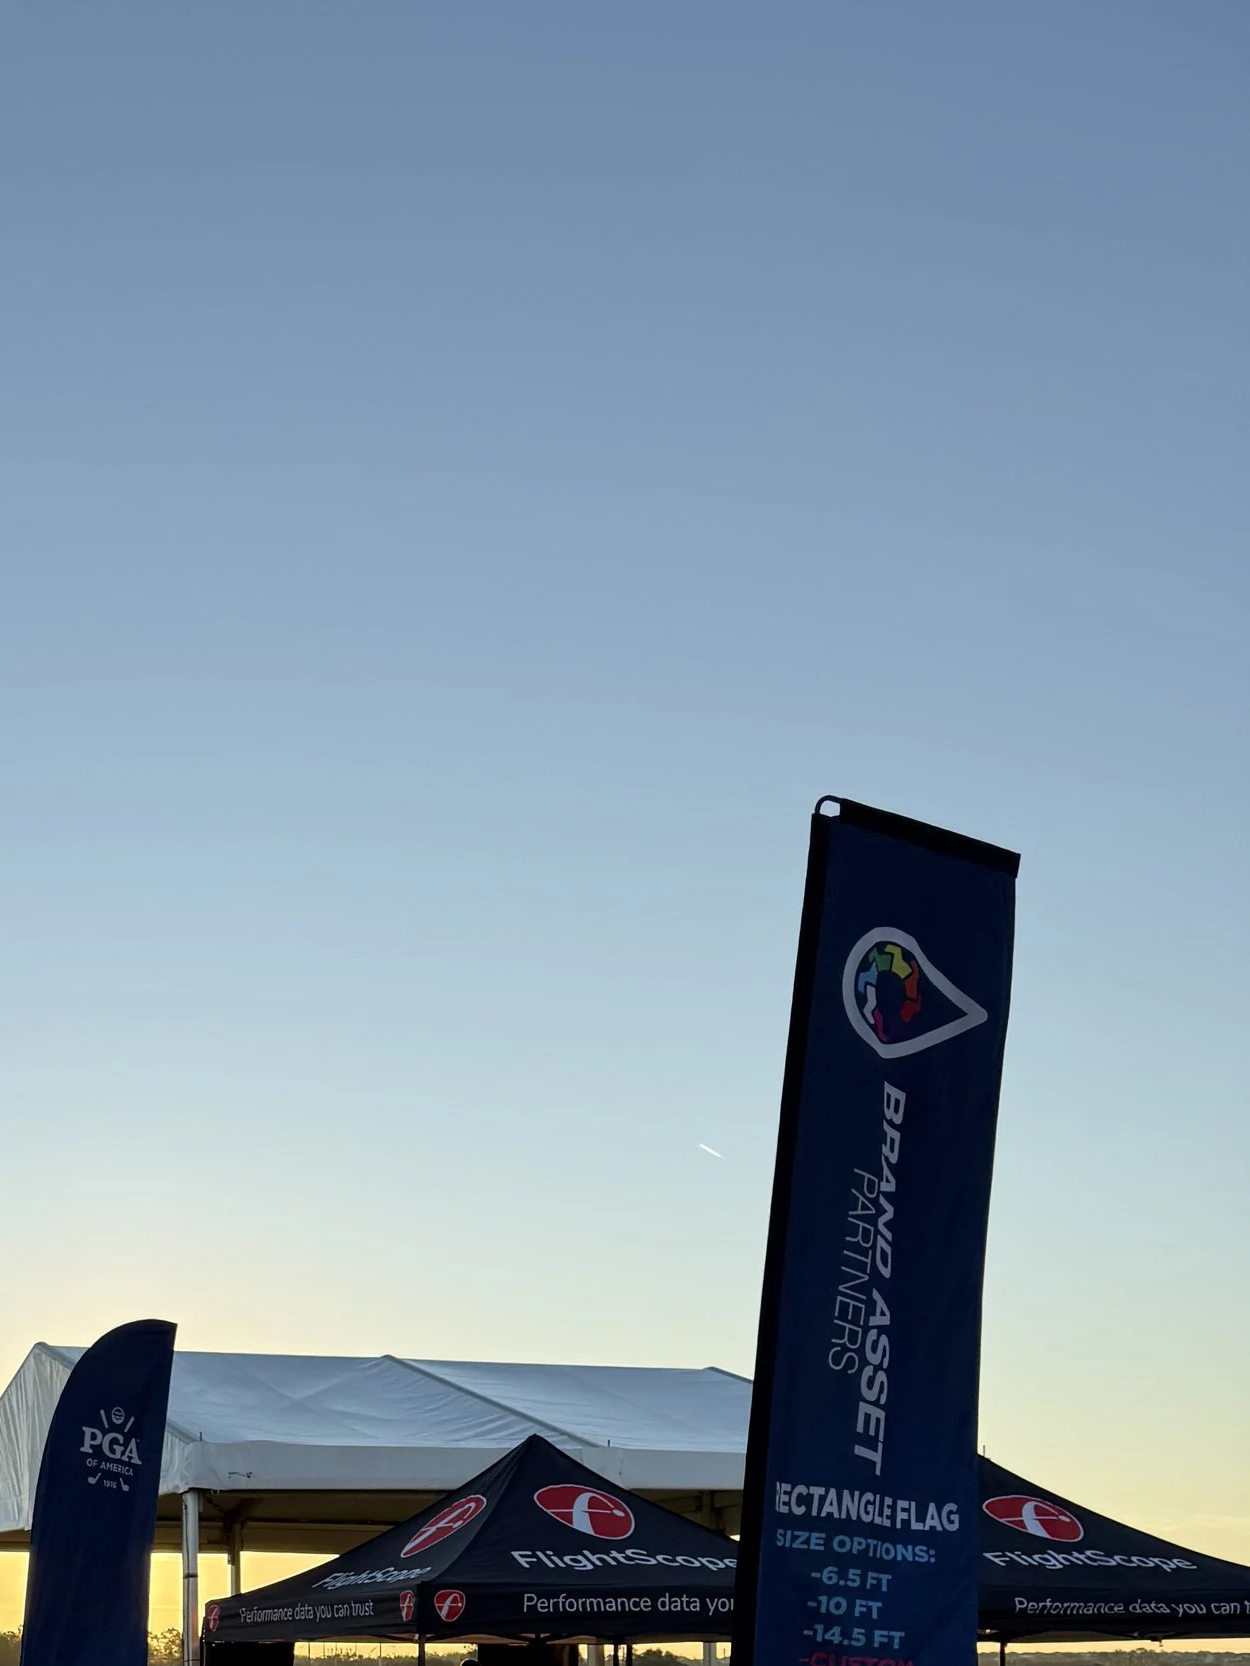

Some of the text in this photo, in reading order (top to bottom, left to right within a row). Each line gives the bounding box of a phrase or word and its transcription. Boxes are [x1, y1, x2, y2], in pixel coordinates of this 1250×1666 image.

[828, 1168, 878, 1374] PARTNERS
[854, 1080, 906, 1476] BRAND ASSET
[80, 1426, 143, 1465] PGA
[86, 1458, 134, 1477] OF AMERICA
[896, 1499, 959, 1532] FLAG
[776, 1528, 936, 1563] SIZE OPTIONS:
[511, 1549, 737, 1571] FlightScope
[983, 1549, 1197, 1573] FlightScope
[311, 1566, 432, 1590] FlightScope
[811, 1566, 892, 1592] -6.5 FT
[239, 1599, 374, 1623] Performance data you can trust
[523, 1593, 652, 1613] Performance
[657, 1593, 700, 1611] data
[854, 1599, 882, 1620] FT
[1014, 1597, 1126, 1614] Performance
[1129, 1599, 1170, 1614] data
[1171, 1600, 1206, 1617] you
[1211, 1600, 1240, 1614] can
[803, 1624, 905, 1650] -14.5 FT
